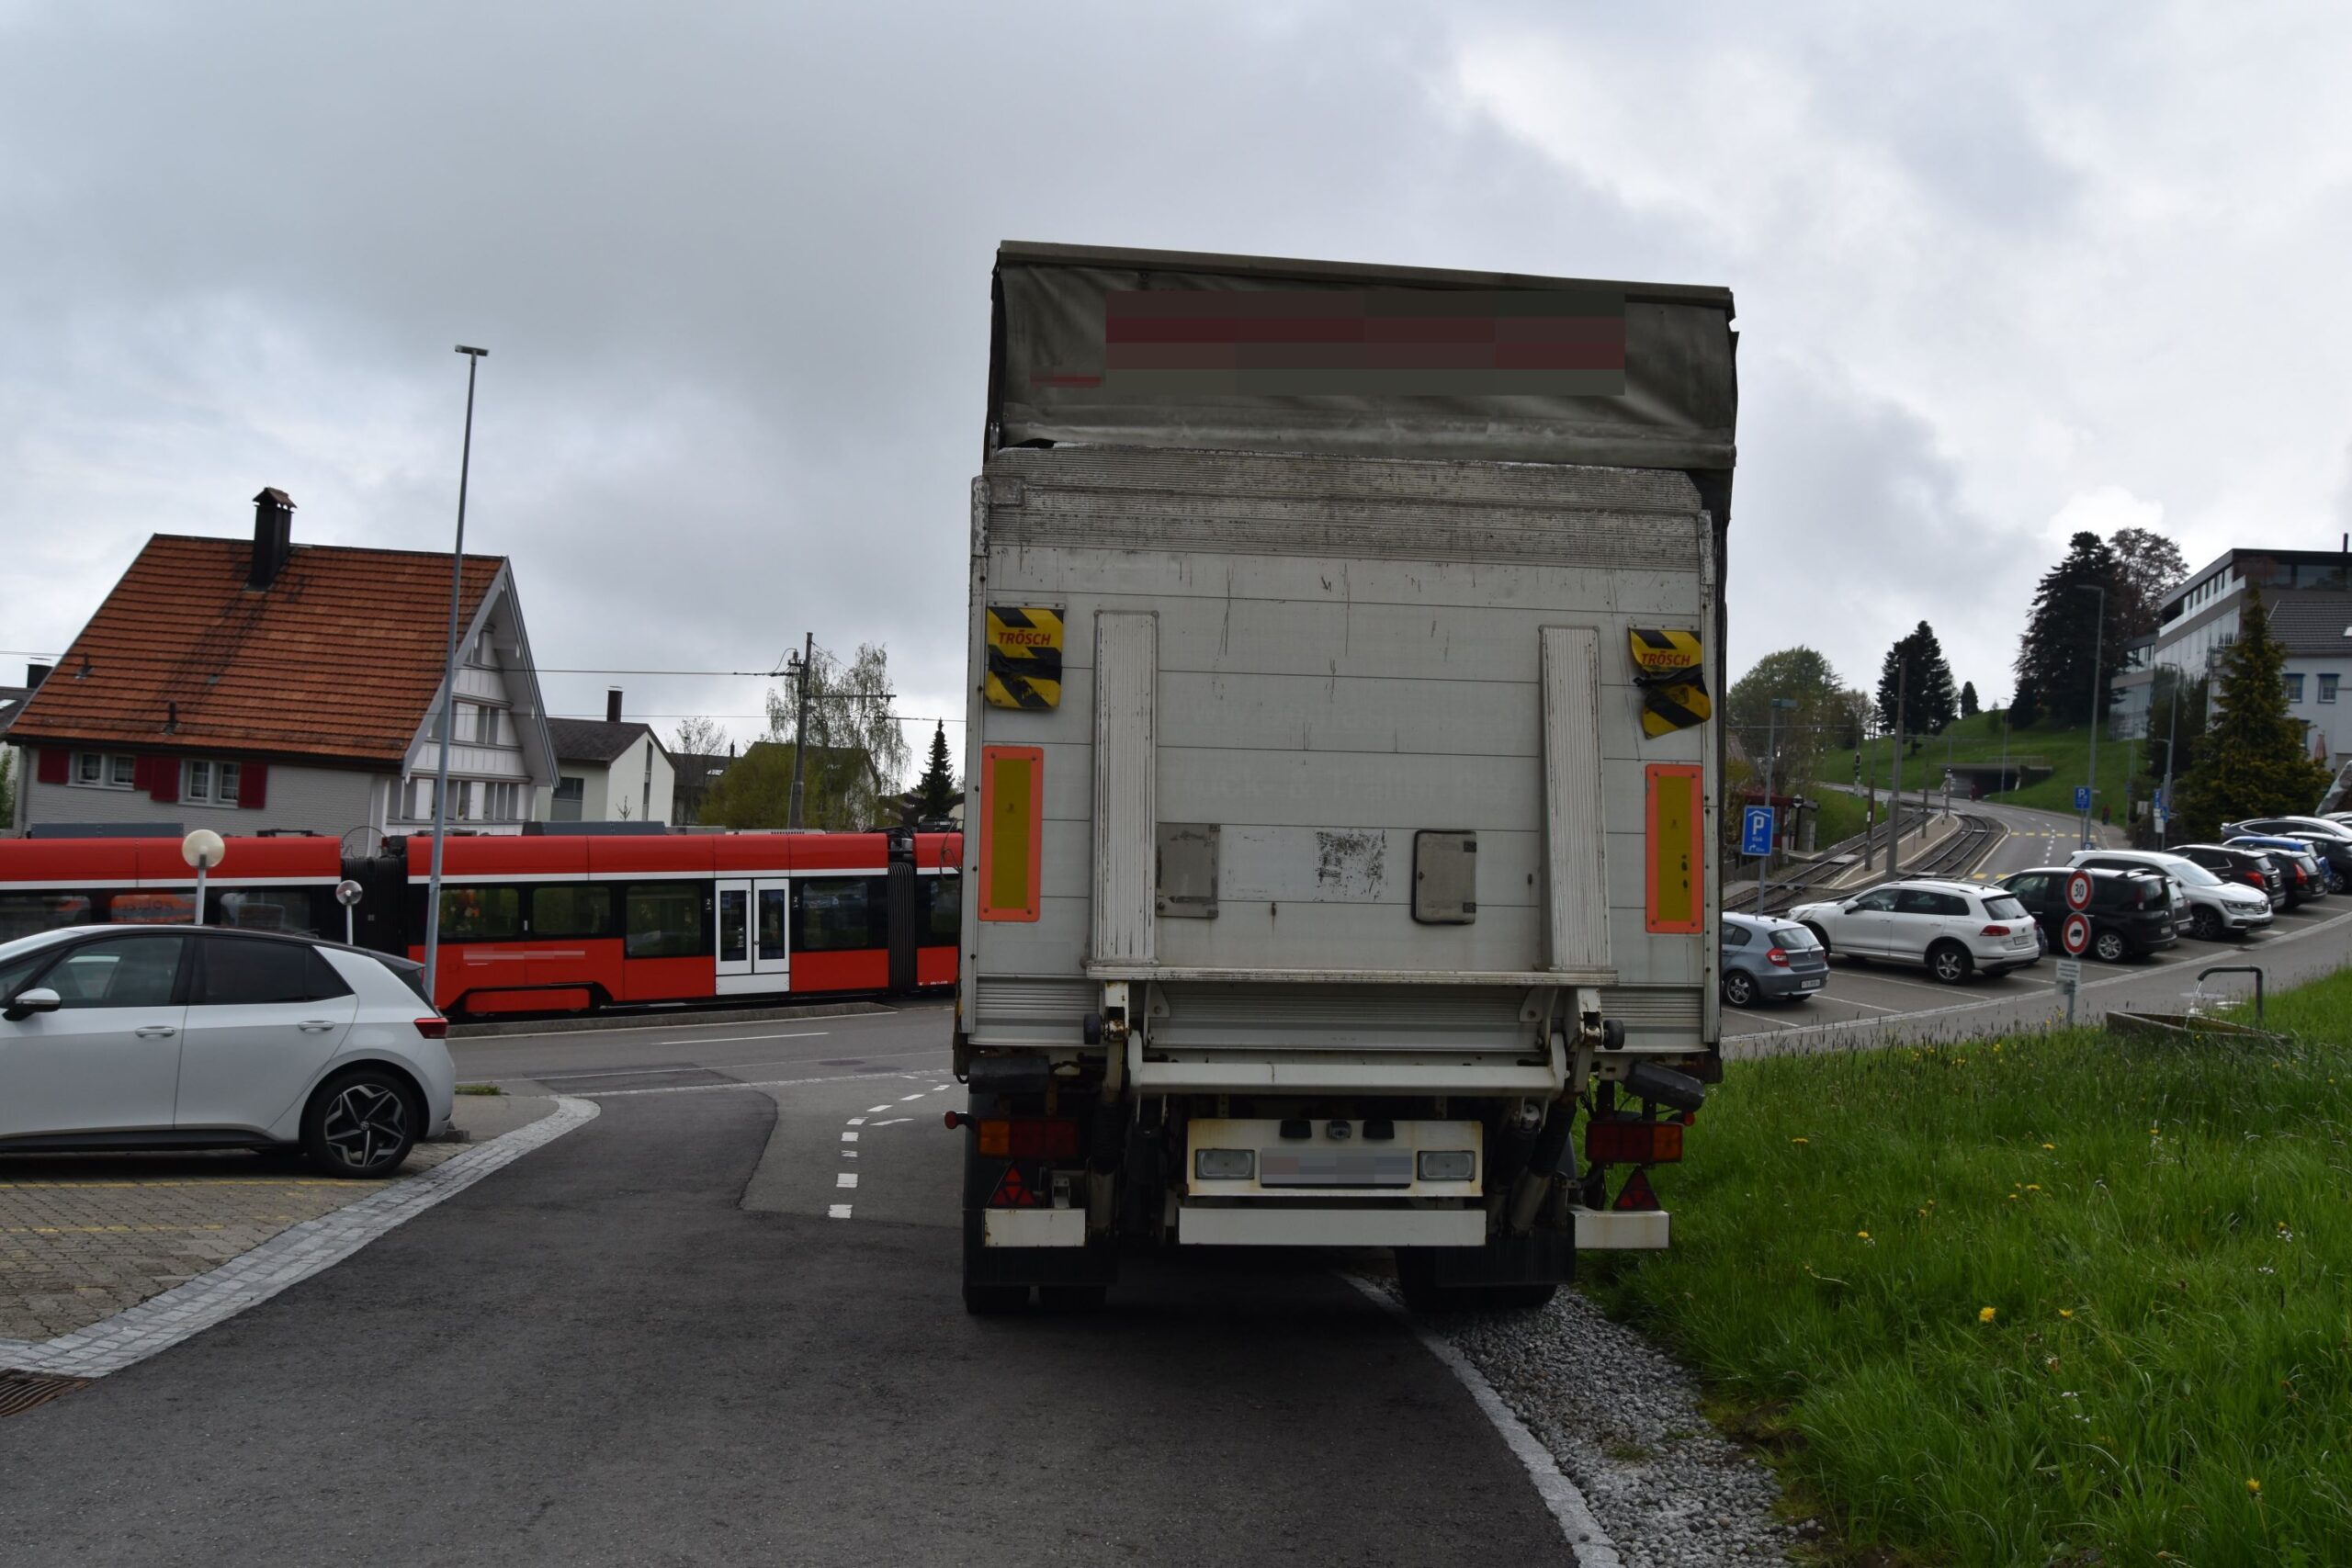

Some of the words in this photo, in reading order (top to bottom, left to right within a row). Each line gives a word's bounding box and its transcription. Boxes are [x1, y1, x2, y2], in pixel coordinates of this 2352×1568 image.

[999, 629, 1051, 645] TRÖSCH
[1641, 650, 1690, 665] TRÖSCH
[1753, 817, 1764, 835] P
[2074, 884, 2084, 897] 30
